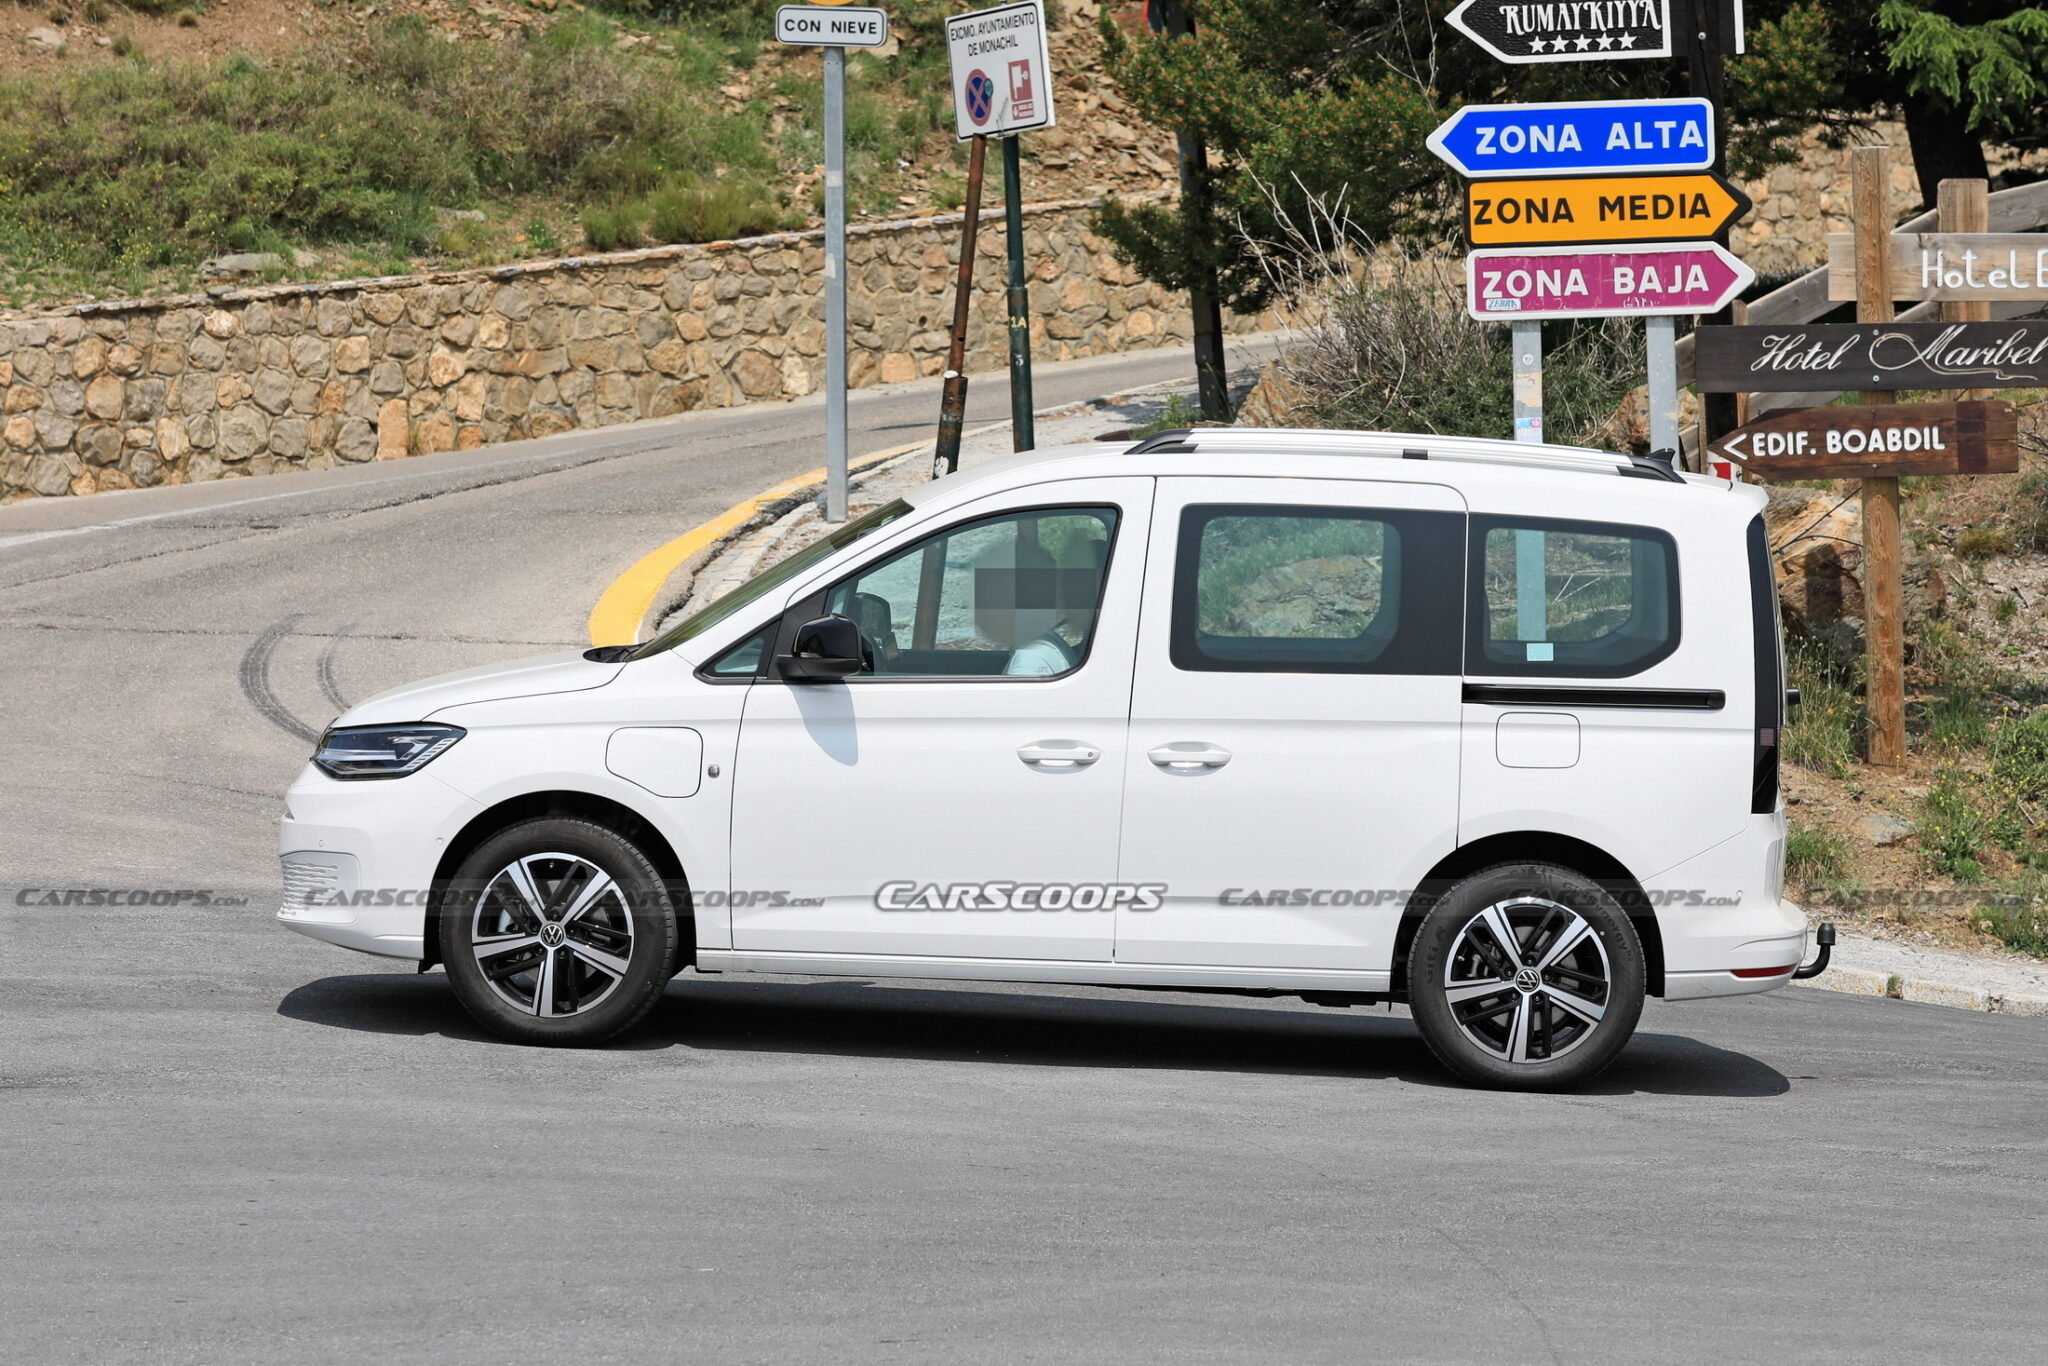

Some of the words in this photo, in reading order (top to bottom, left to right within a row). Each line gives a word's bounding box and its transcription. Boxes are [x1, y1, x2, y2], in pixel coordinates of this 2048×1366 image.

[785, 19, 821, 33] CON
[831, 20, 877, 35] NIEVE
[951, 24, 977, 41] EXCMO.
[978, 12, 1035, 34] AYUNTAMIENTO
[968, 42, 979, 56] DE
[979, 34, 1018, 54] MONACHIL
[1476, 123, 1582, 155] ZONA
[1606, 120, 1705, 150] ALTA
[1474, 198, 1574, 225] ZONA
[1599, 193, 1712, 222] MEDIA
[1482, 269, 1589, 299] ZONA
[1613, 265, 1710, 295] BAJA
[1751, 334, 1860, 371] Hotel
[1893, 324, 2048, 372] Maribel
[1752, 430, 1817, 456] EDIF.
[1826, 425, 1946, 455] BOABDIL
